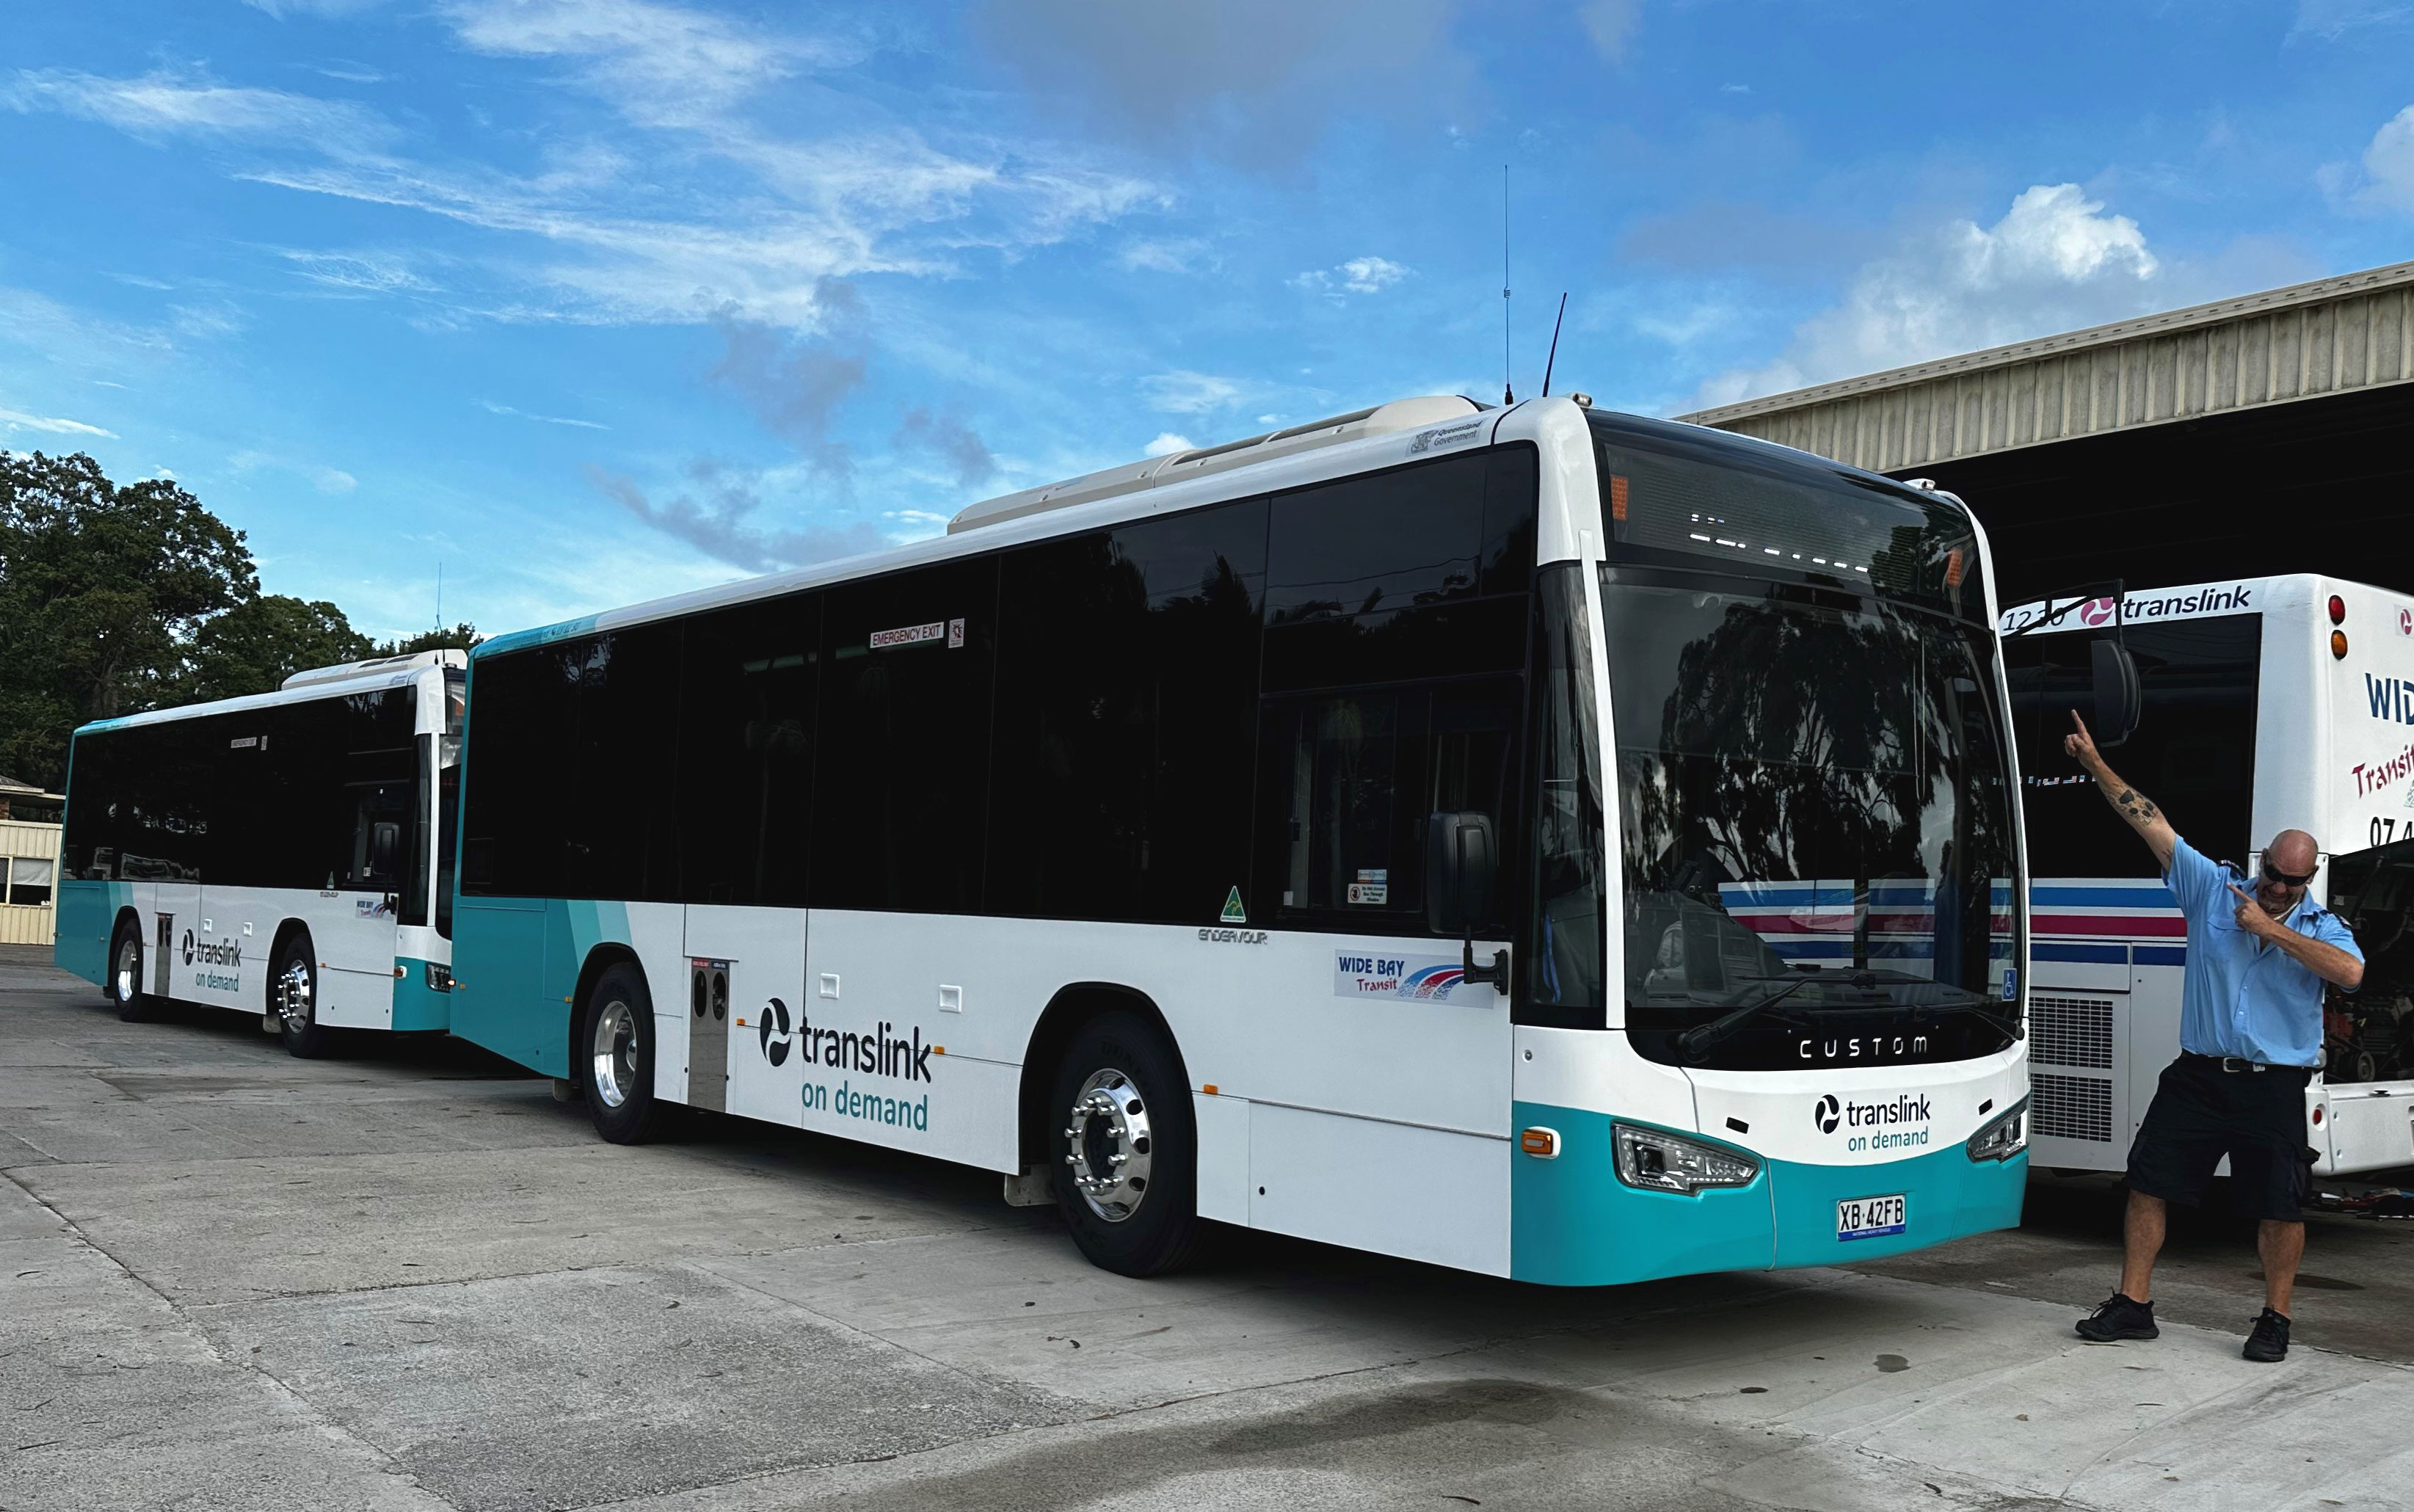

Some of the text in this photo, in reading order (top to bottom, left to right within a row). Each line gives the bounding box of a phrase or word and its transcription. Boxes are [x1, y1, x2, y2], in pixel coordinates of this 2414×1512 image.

[1434, 429, 1477, 446] Government
[1438, 421, 1483, 436] Queensland
[2123, 585, 2252, 619] translink
[873, 624, 942, 646] EMERGENCY EXIT
[1198, 928, 1268, 945] ENDEAVOUR
[197, 937, 241, 967] translink
[1339, 956, 1405, 978] WIDE BAY
[195, 969, 239, 992] on demand
[1356, 977, 1397, 992] Transit
[799, 1016, 931, 1084] translink
[1800, 1036, 1928, 1058] CUSTOM
[801, 1080, 928, 1132] on demand
[1846, 1093, 1931, 1127] translink
[1848, 1125, 1929, 1152] on demand
